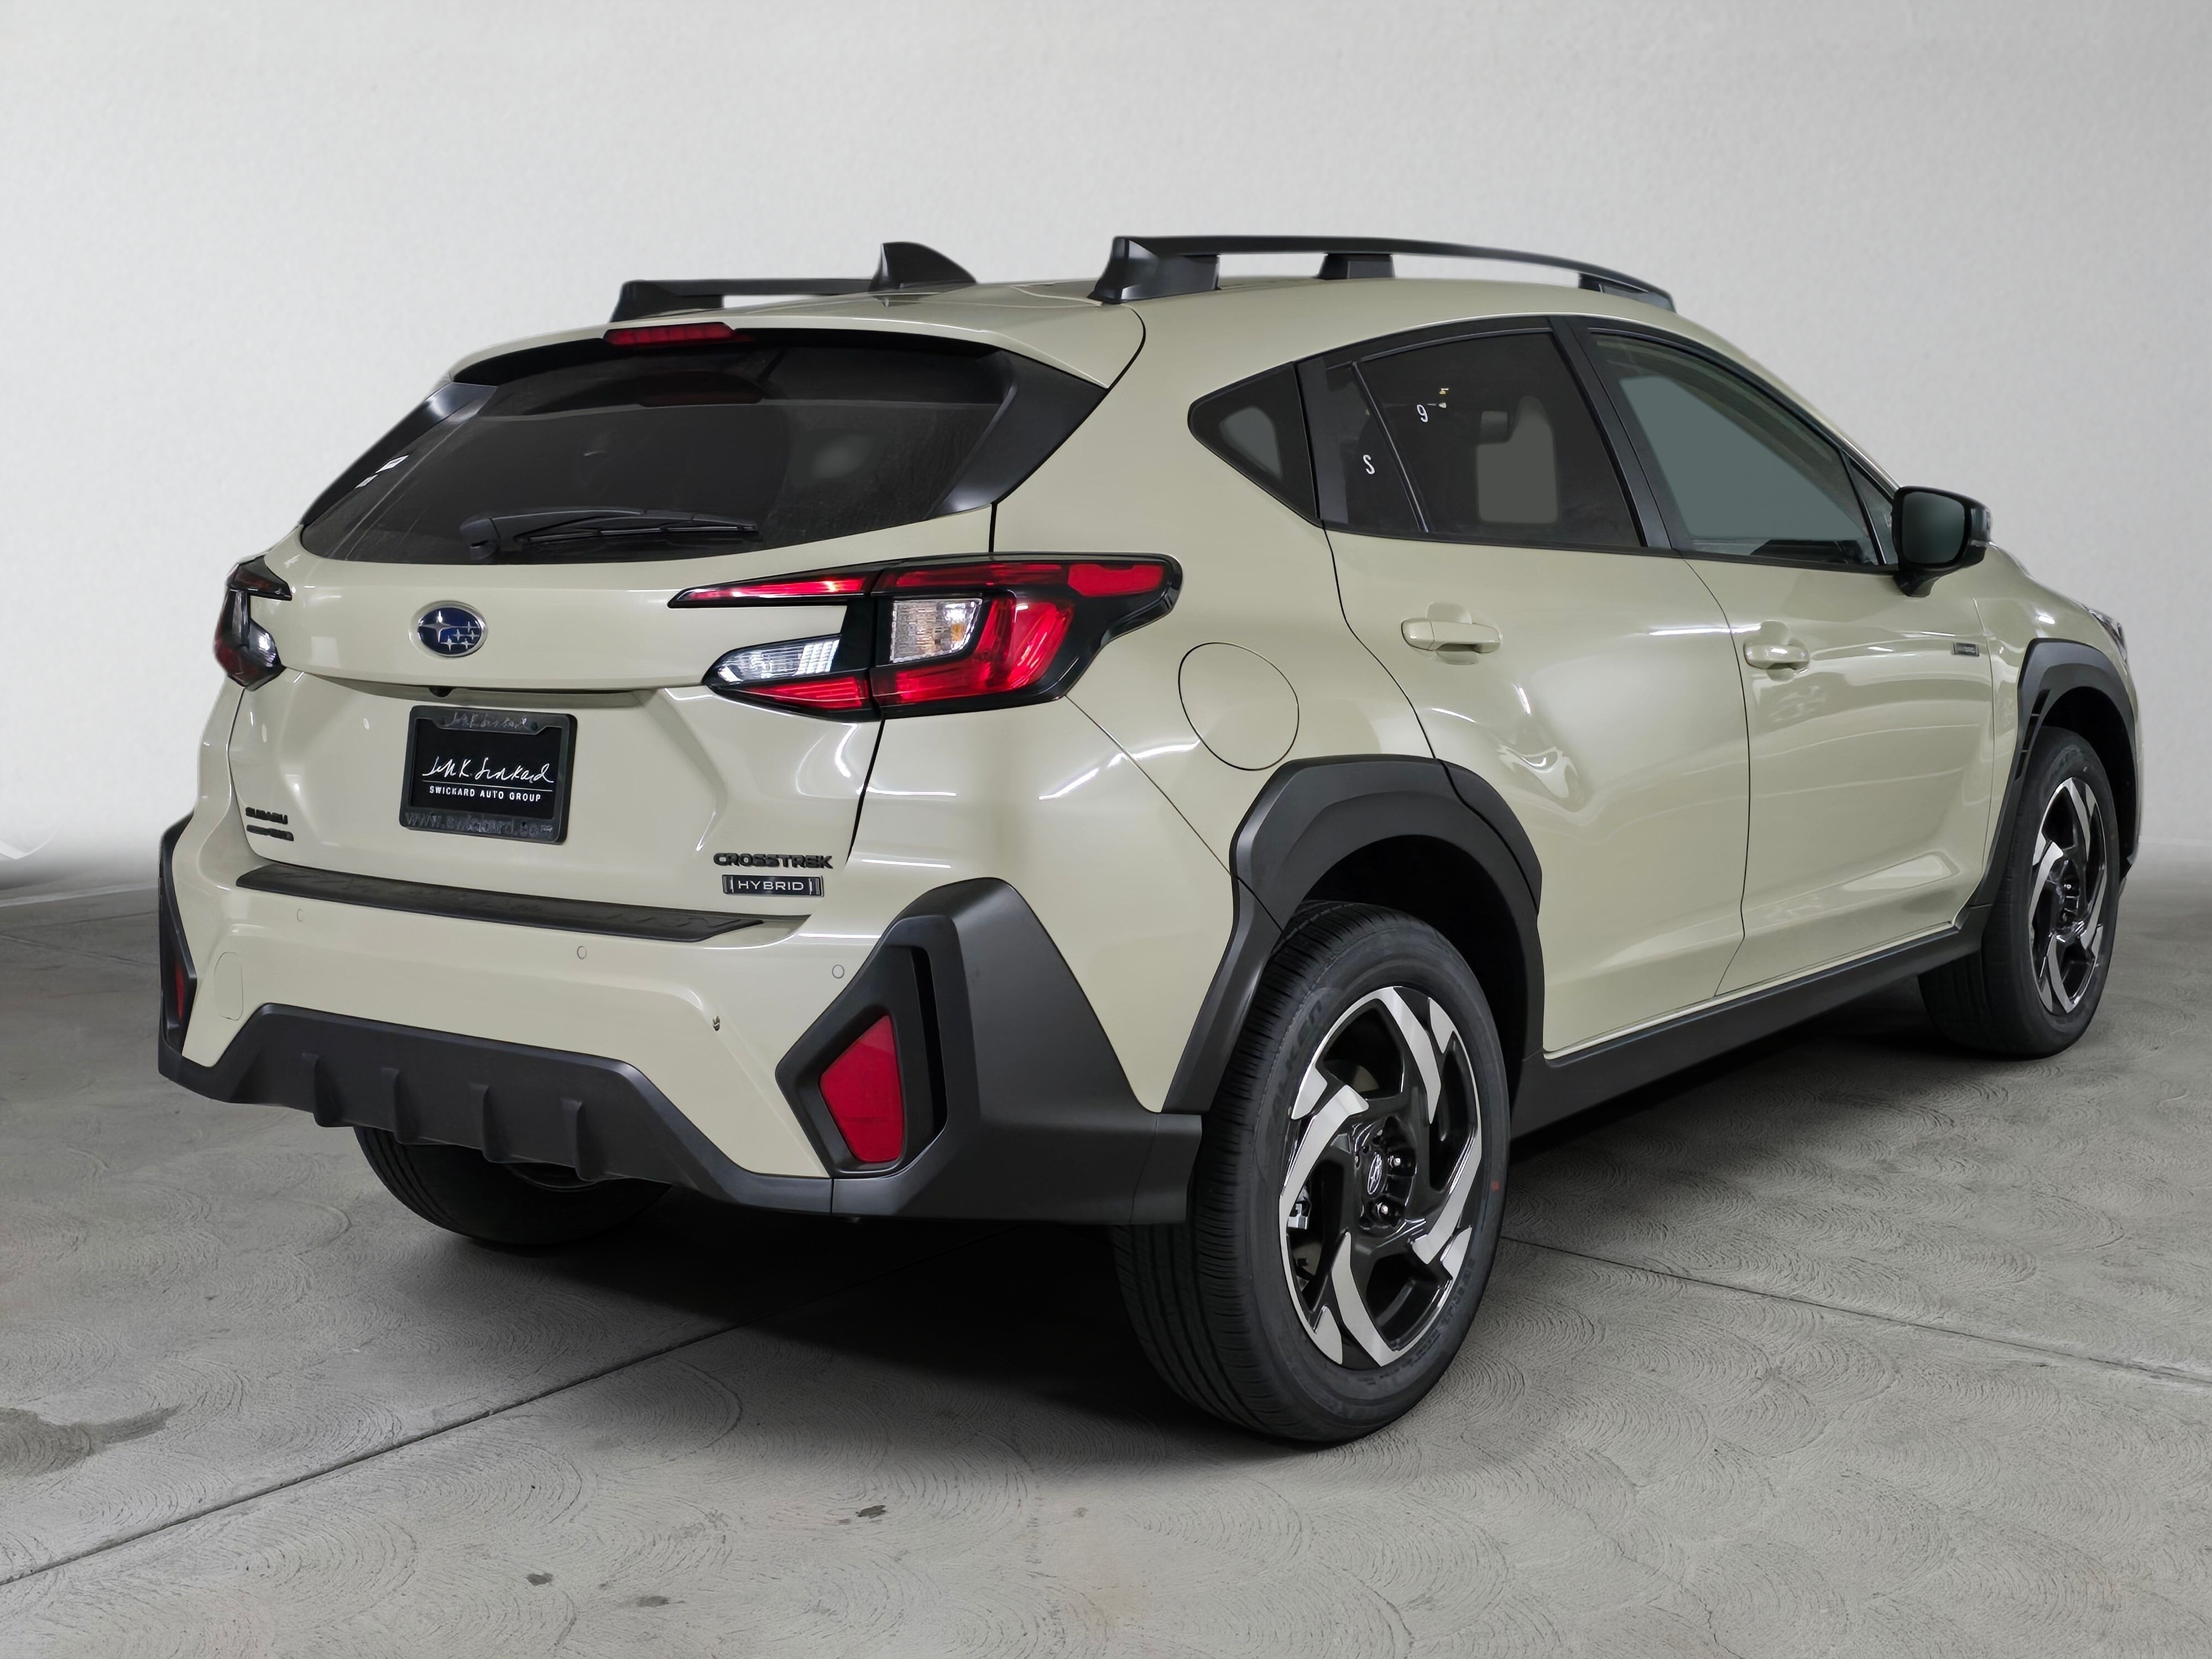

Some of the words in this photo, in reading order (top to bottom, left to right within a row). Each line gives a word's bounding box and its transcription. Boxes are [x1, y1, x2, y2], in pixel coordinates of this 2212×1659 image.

[429, 785, 475, 797] SWICKARD
[480, 789, 504, 800] AUTO
[509, 792, 541, 802] GROUP
[713, 853, 833, 869] CROSSTREK
[738, 880, 805, 891] HYBRID
